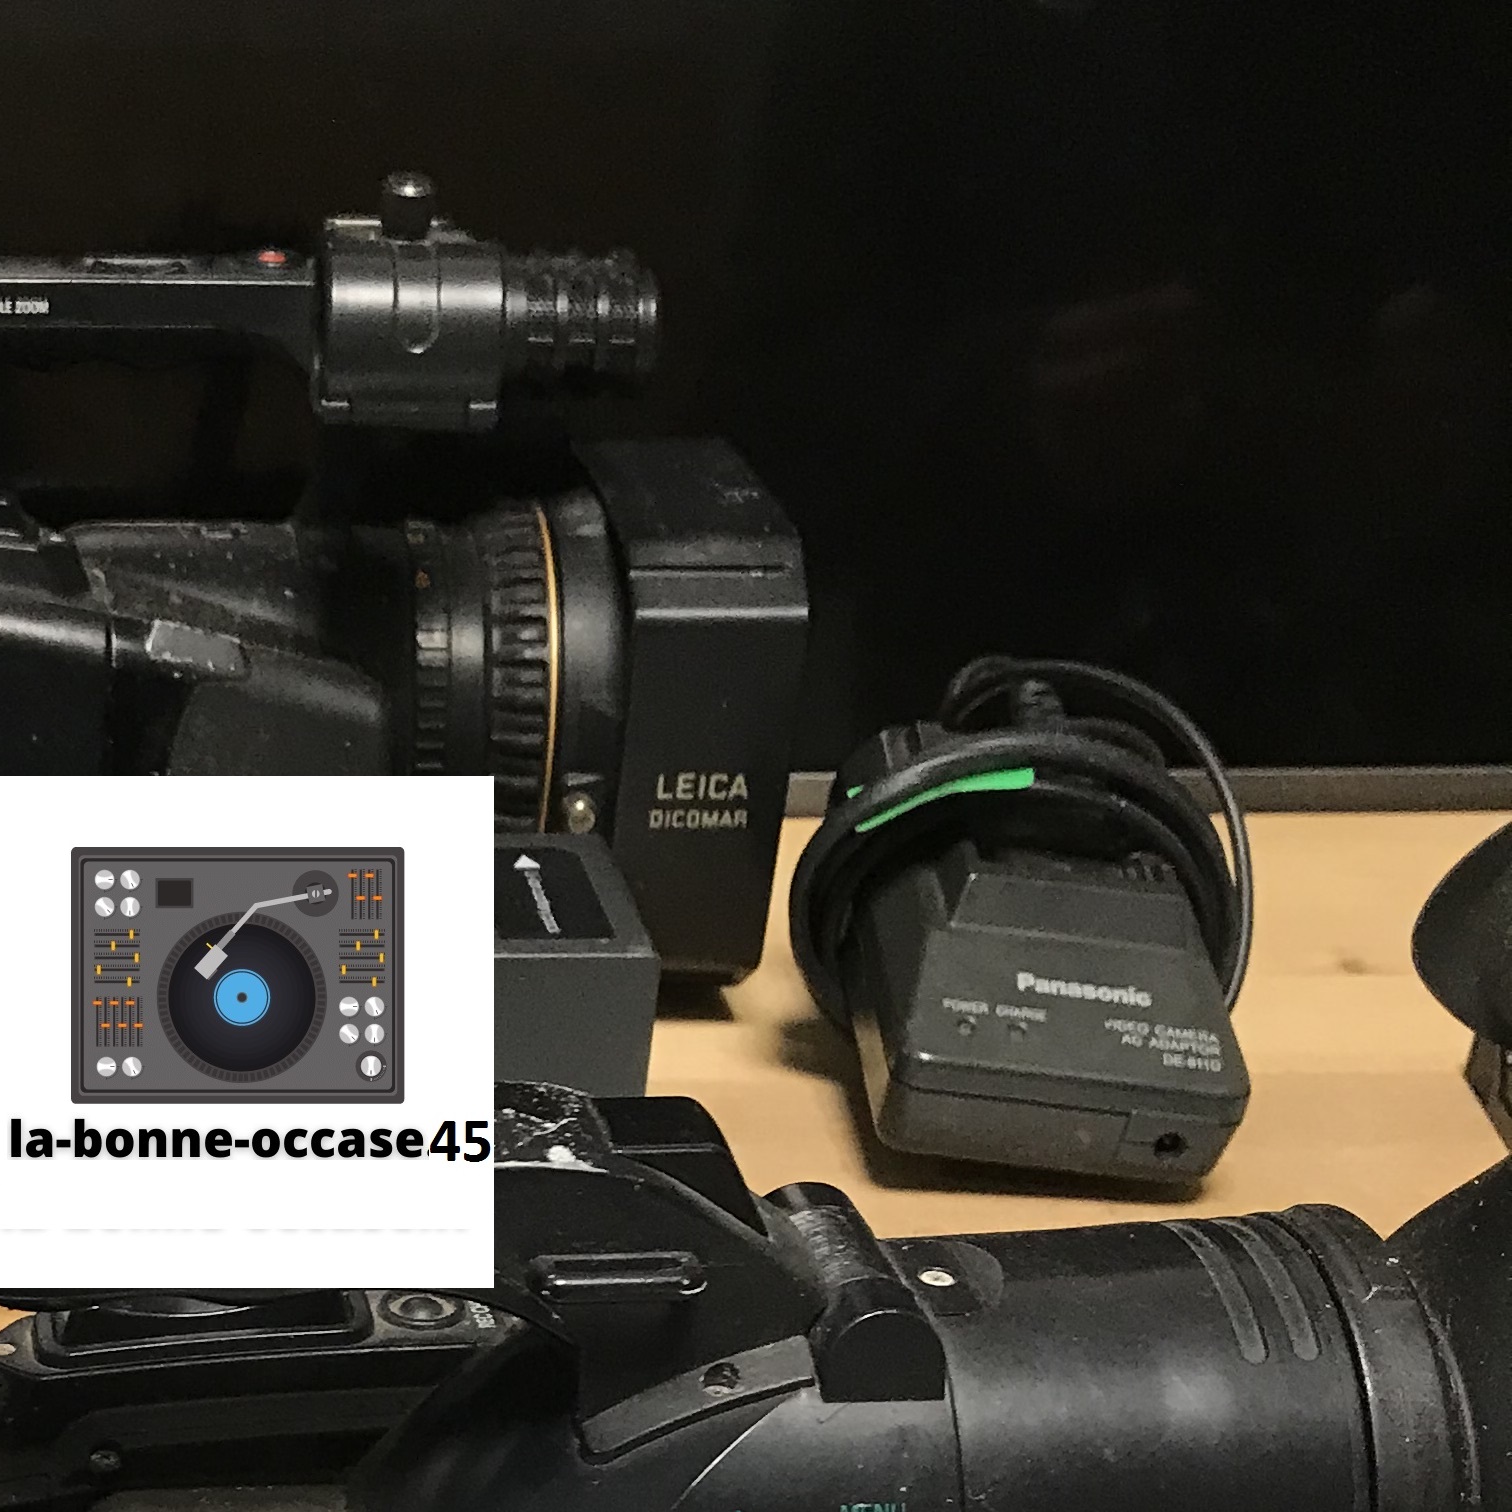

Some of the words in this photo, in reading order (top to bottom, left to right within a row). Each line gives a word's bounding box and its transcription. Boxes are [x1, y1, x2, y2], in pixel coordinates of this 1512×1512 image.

[657, 772, 748, 800] LEICA
[649, 808, 747, 829] DICOMAR
[1017, 971, 1153, 1007] Panasonic
[1154, 1024, 1219, 1044] CAMERA
